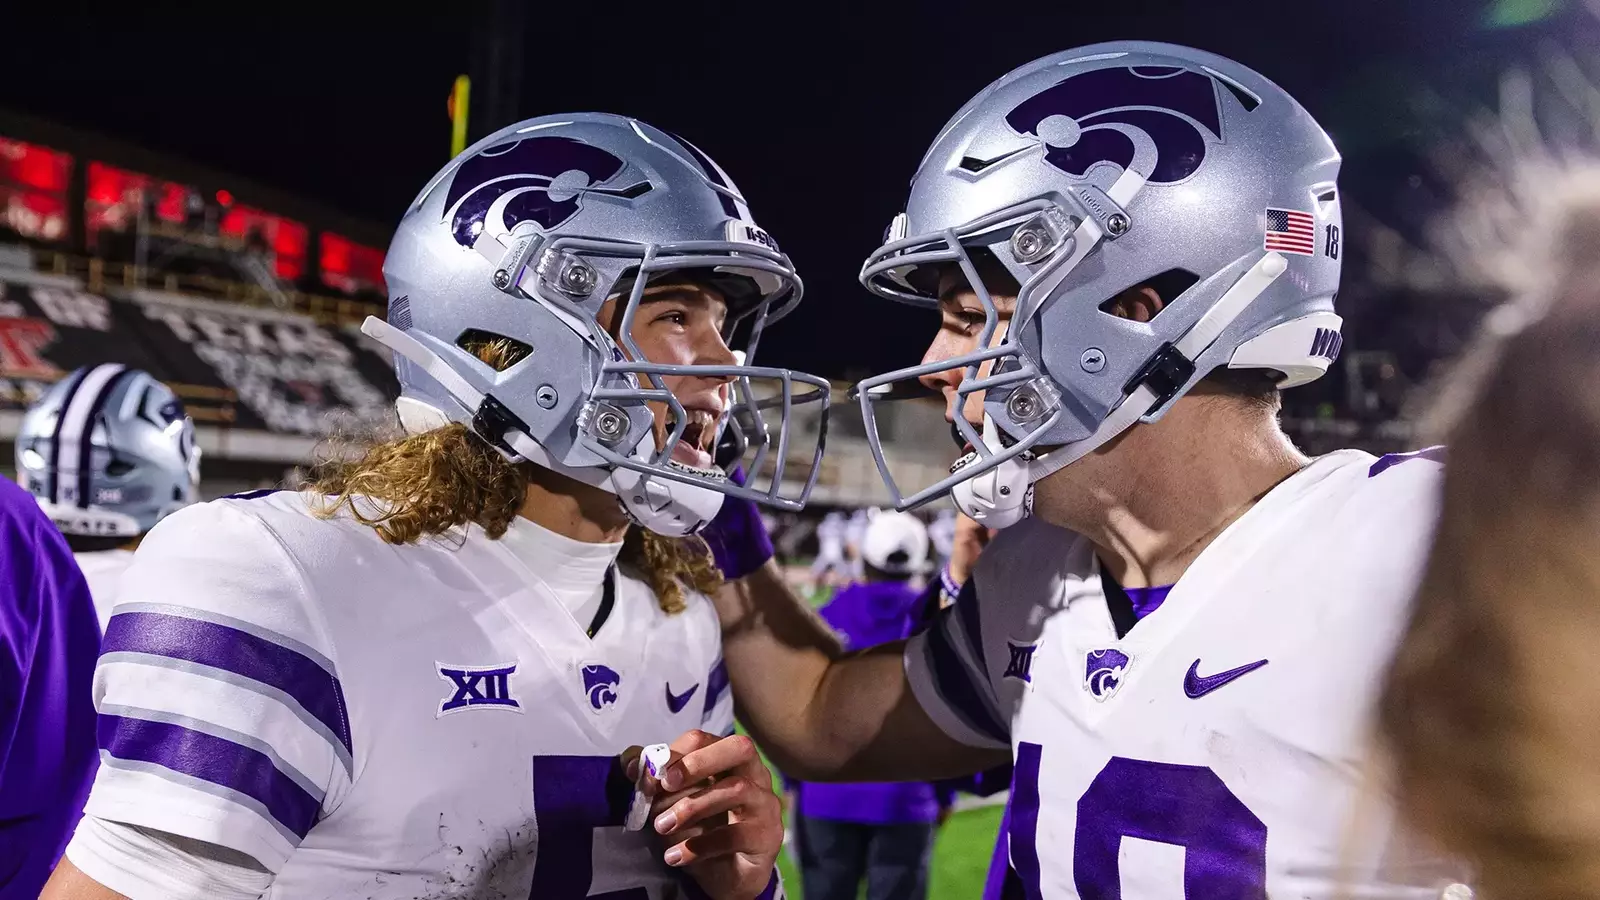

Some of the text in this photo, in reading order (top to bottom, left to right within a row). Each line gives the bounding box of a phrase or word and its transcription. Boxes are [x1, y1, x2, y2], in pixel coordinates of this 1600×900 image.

[1325, 224, 1339, 260] 18
[1003, 641, 1037, 683] XII
[440, 664, 520, 712] XII
